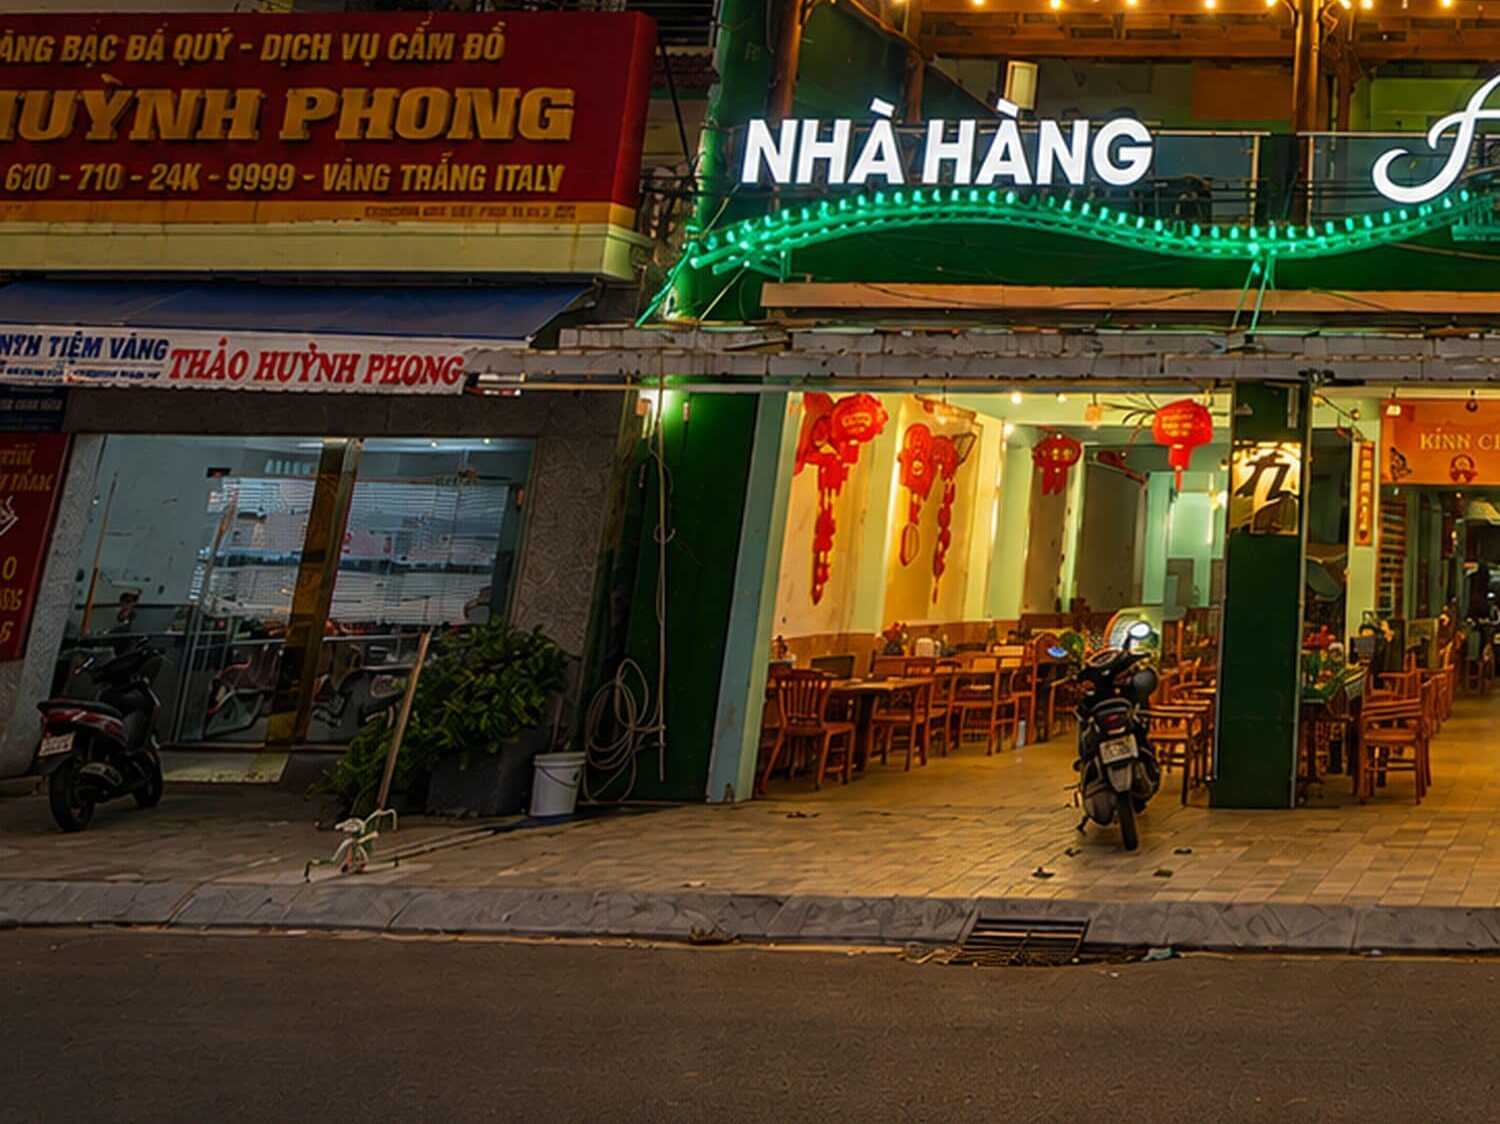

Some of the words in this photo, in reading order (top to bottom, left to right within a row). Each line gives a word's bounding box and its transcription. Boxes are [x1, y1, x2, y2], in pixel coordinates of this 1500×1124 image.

[59, 32, 119, 69] BẠC
[260, 31, 332, 68] DỊCH
[341, 32, 380, 69] VỤ
[278, 85, 578, 142] PHONG
[740, 96, 906, 185] NHÀ
[921, 97, 1154, 187] HÀNG
[77, 161, 124, 194] 710
[147, 161, 204, 194] 24K
[225, 161, 297, 194] 9999
[493, 162, 567, 194] ITALY
[170, 338, 249, 381] THẢO
[253, 343, 361, 385] HUỲNH
[362, 354, 464, 386] PHONG
